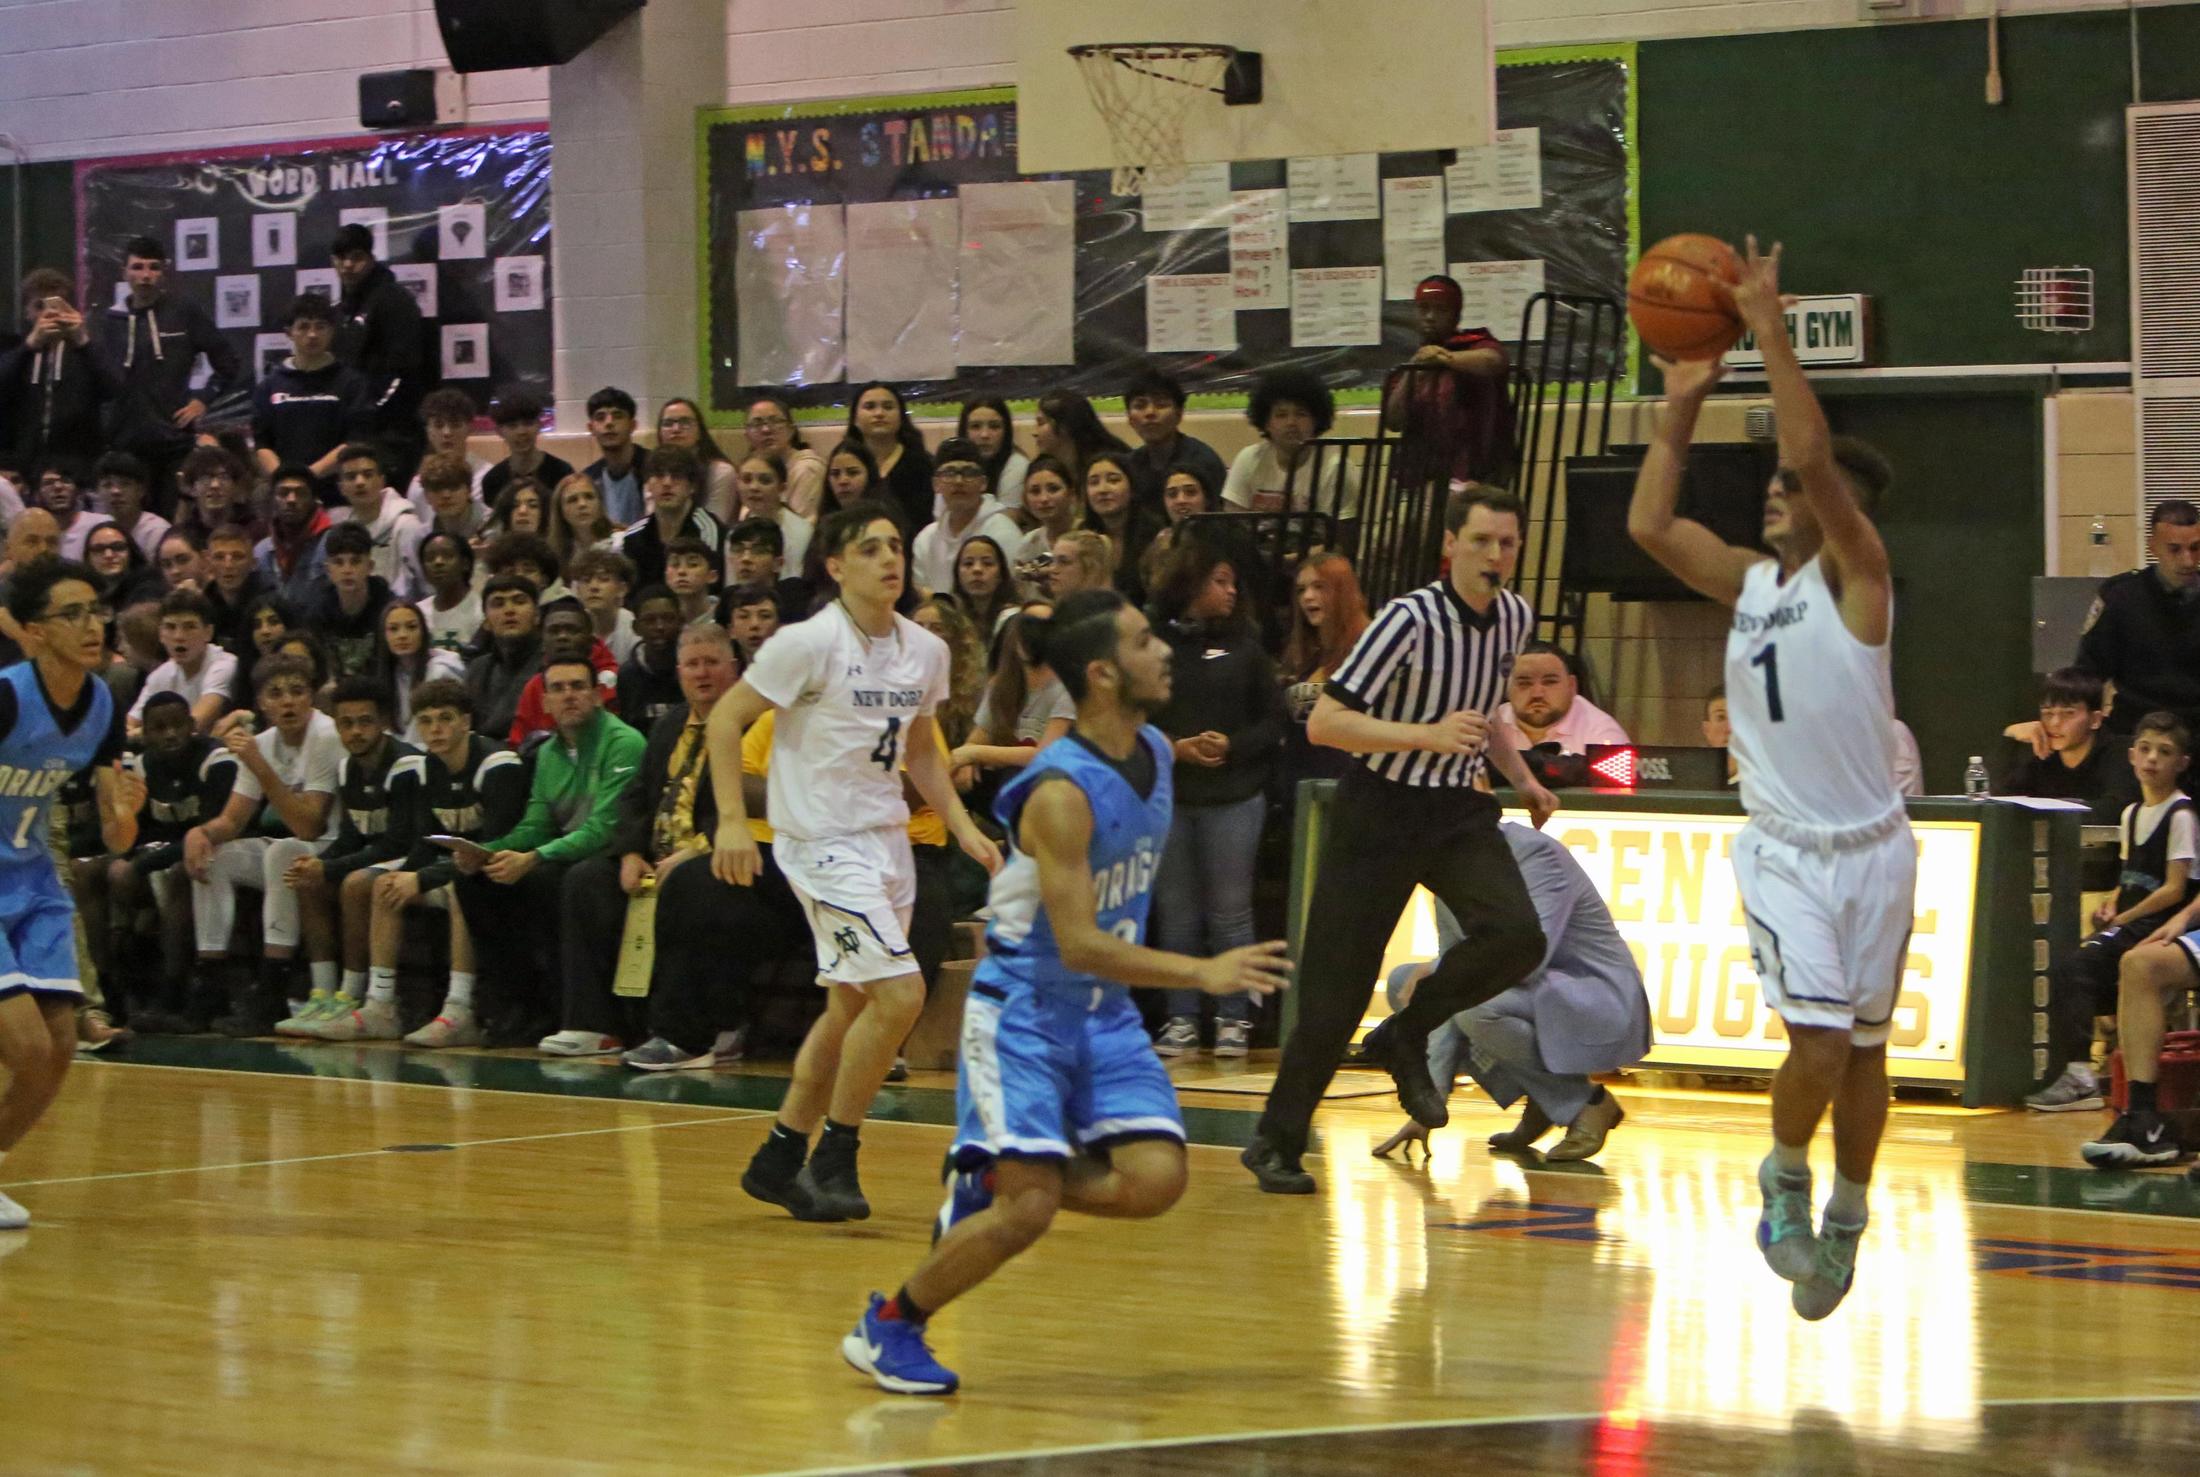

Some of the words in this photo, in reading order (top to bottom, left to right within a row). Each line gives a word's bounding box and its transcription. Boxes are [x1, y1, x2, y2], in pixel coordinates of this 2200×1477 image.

[745, 127, 843, 177] N.Y.S.
[1806, 311, 1853, 348] GYM
[852, 689, 884, 708] NEW
[1750, 642, 1784, 723] 1
[870, 716, 901, 773] 4
[13, 806, 39, 849] 1
[2032, 938, 2050, 1081] DORP
